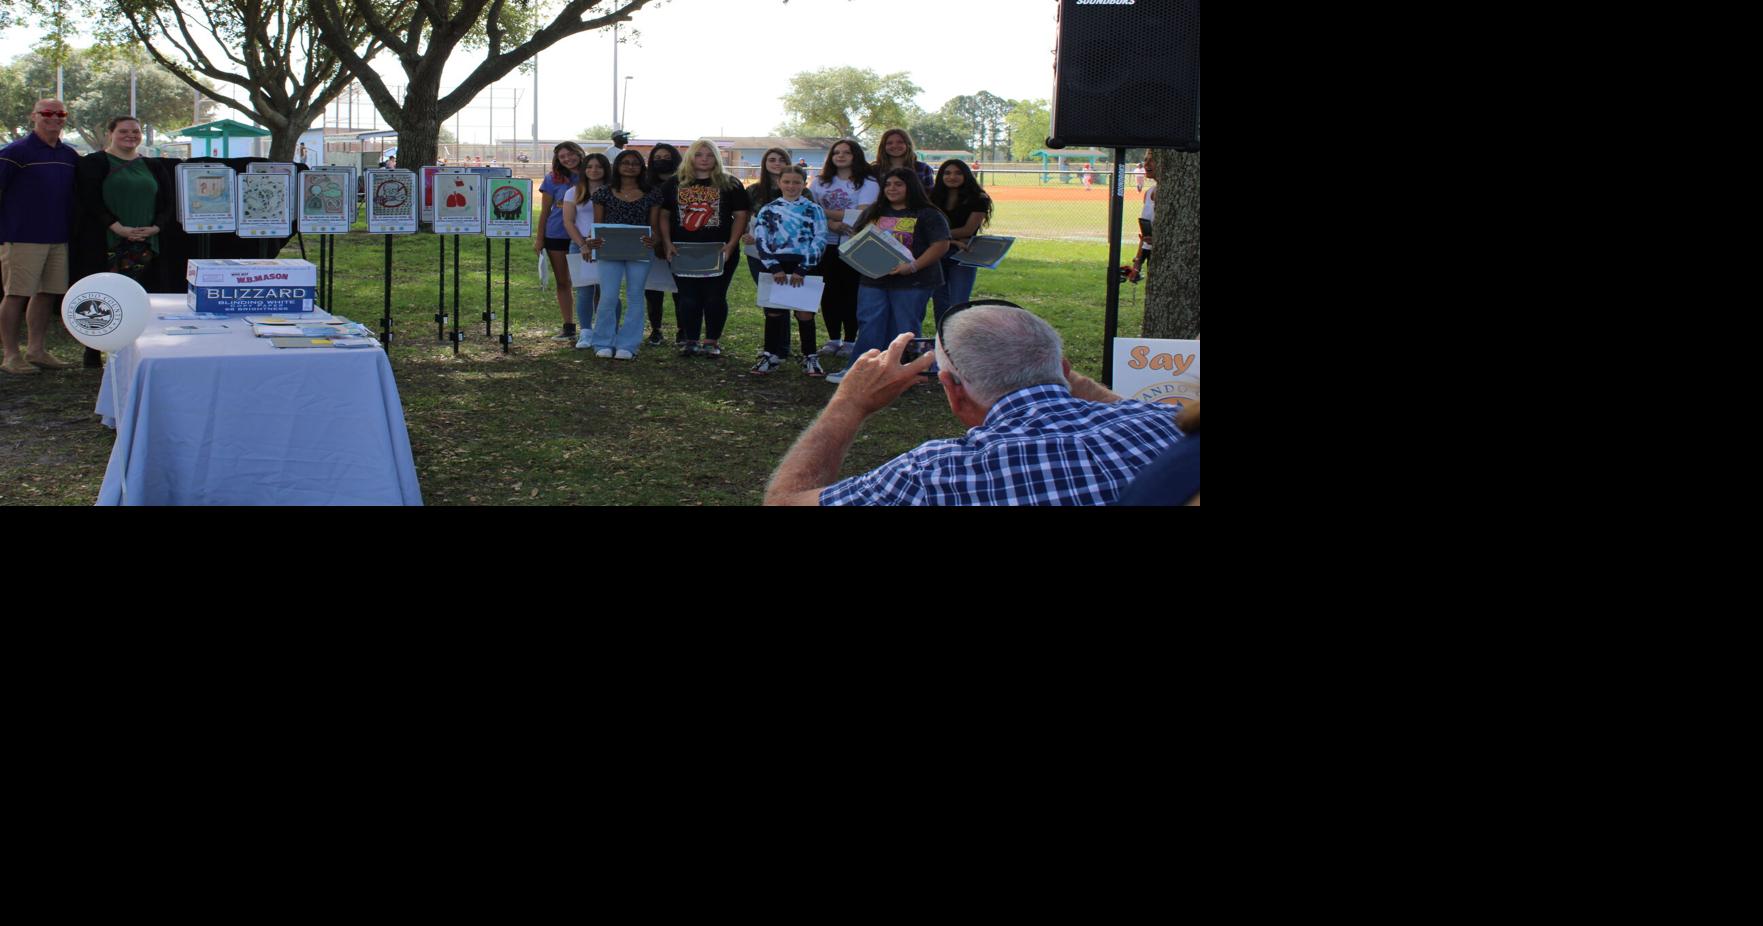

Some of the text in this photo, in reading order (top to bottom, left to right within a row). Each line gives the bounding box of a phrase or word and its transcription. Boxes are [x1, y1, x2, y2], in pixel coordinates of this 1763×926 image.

[207, 288, 306, 299] BLIZZARD
[1128, 345, 1196, 377] Say
[1135, 384, 1188, 401] ANDO
